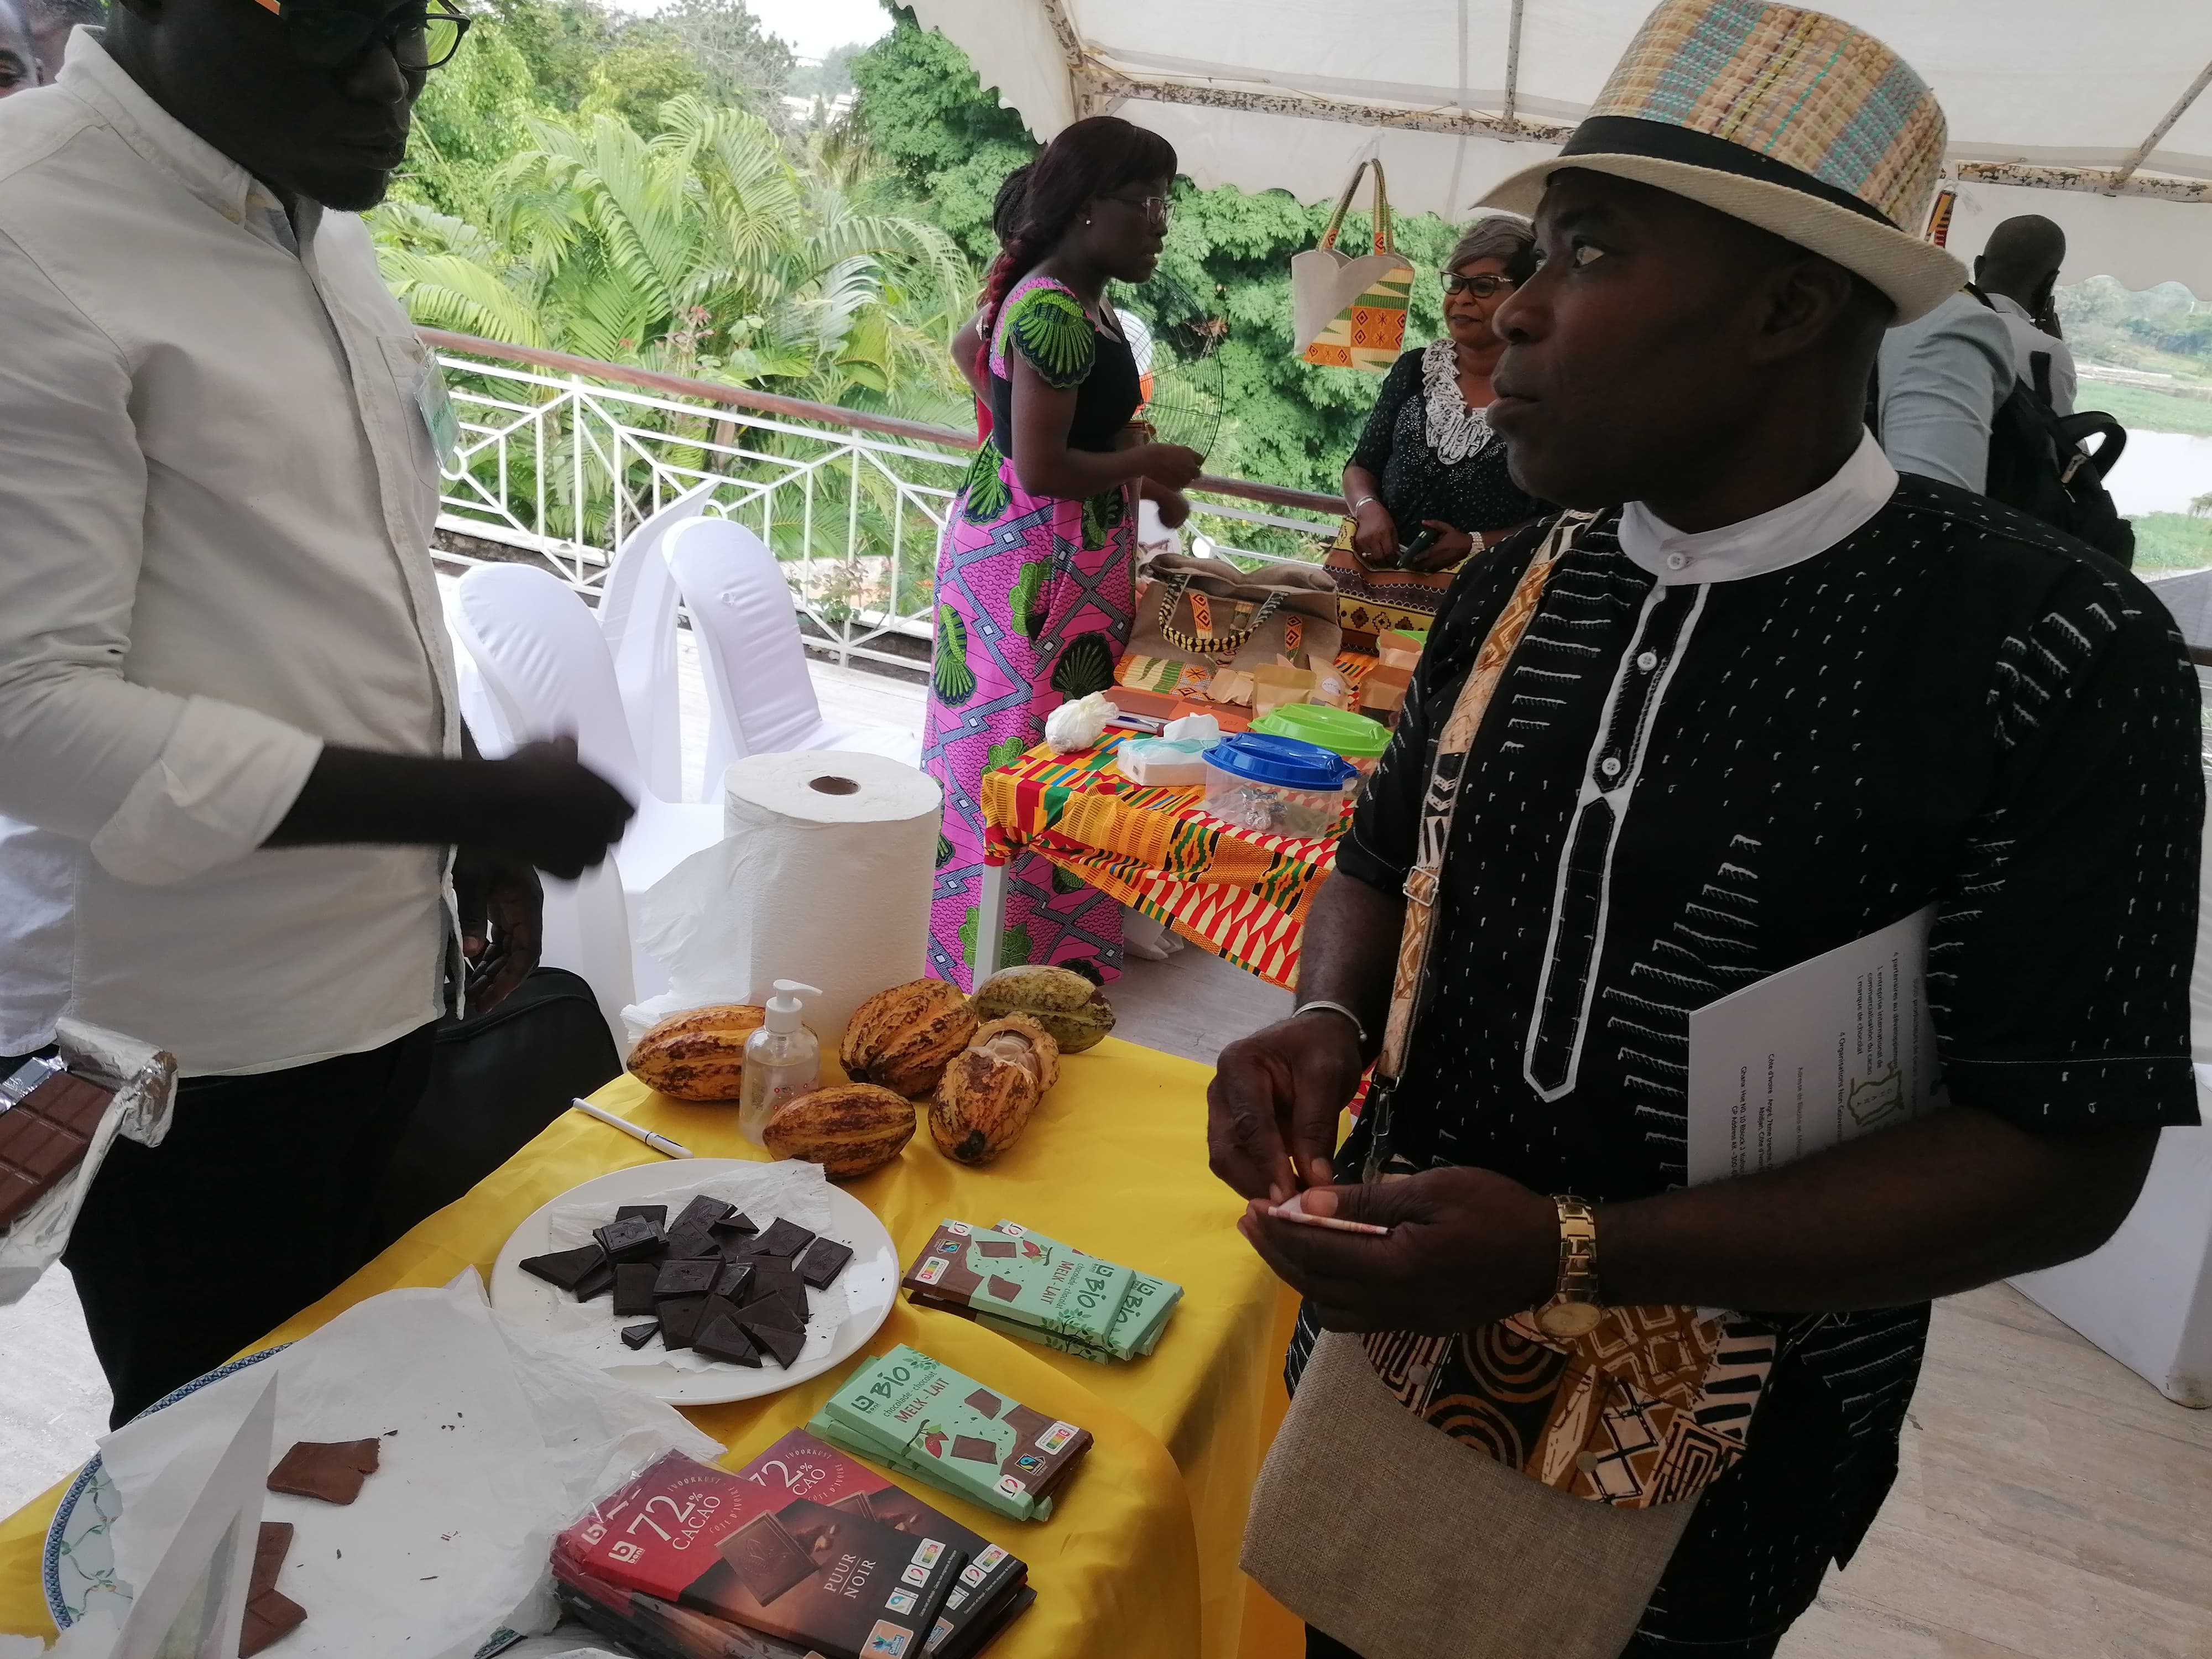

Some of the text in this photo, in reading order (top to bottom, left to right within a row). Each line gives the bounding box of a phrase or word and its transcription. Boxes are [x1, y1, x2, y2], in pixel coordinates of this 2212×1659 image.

[1837, 1038, 1846, 1088] Organisations
[1052, 1260, 1074, 1282] MELK
[1067, 1263, 1084, 1286] chocolade
[1040, 1286, 1061, 1305] LAIT
[1055, 1288, 1072, 1310] chocolat
[883, 1391, 912, 1417] chocolade
[913, 1371, 937, 1391] chocolat
[893, 1397, 928, 1423] MELK
[923, 1377, 950, 1397] LAIT
[785, 1448, 833, 1460] IVOORKUST
[666, 1476, 722, 1493] IVOORKUST
[792, 1468, 827, 1496] CAO
[672, 1496, 721, 1551] CACAO
[823, 1553, 857, 1593] PUUR
[843, 1559, 877, 1600] NOIR
